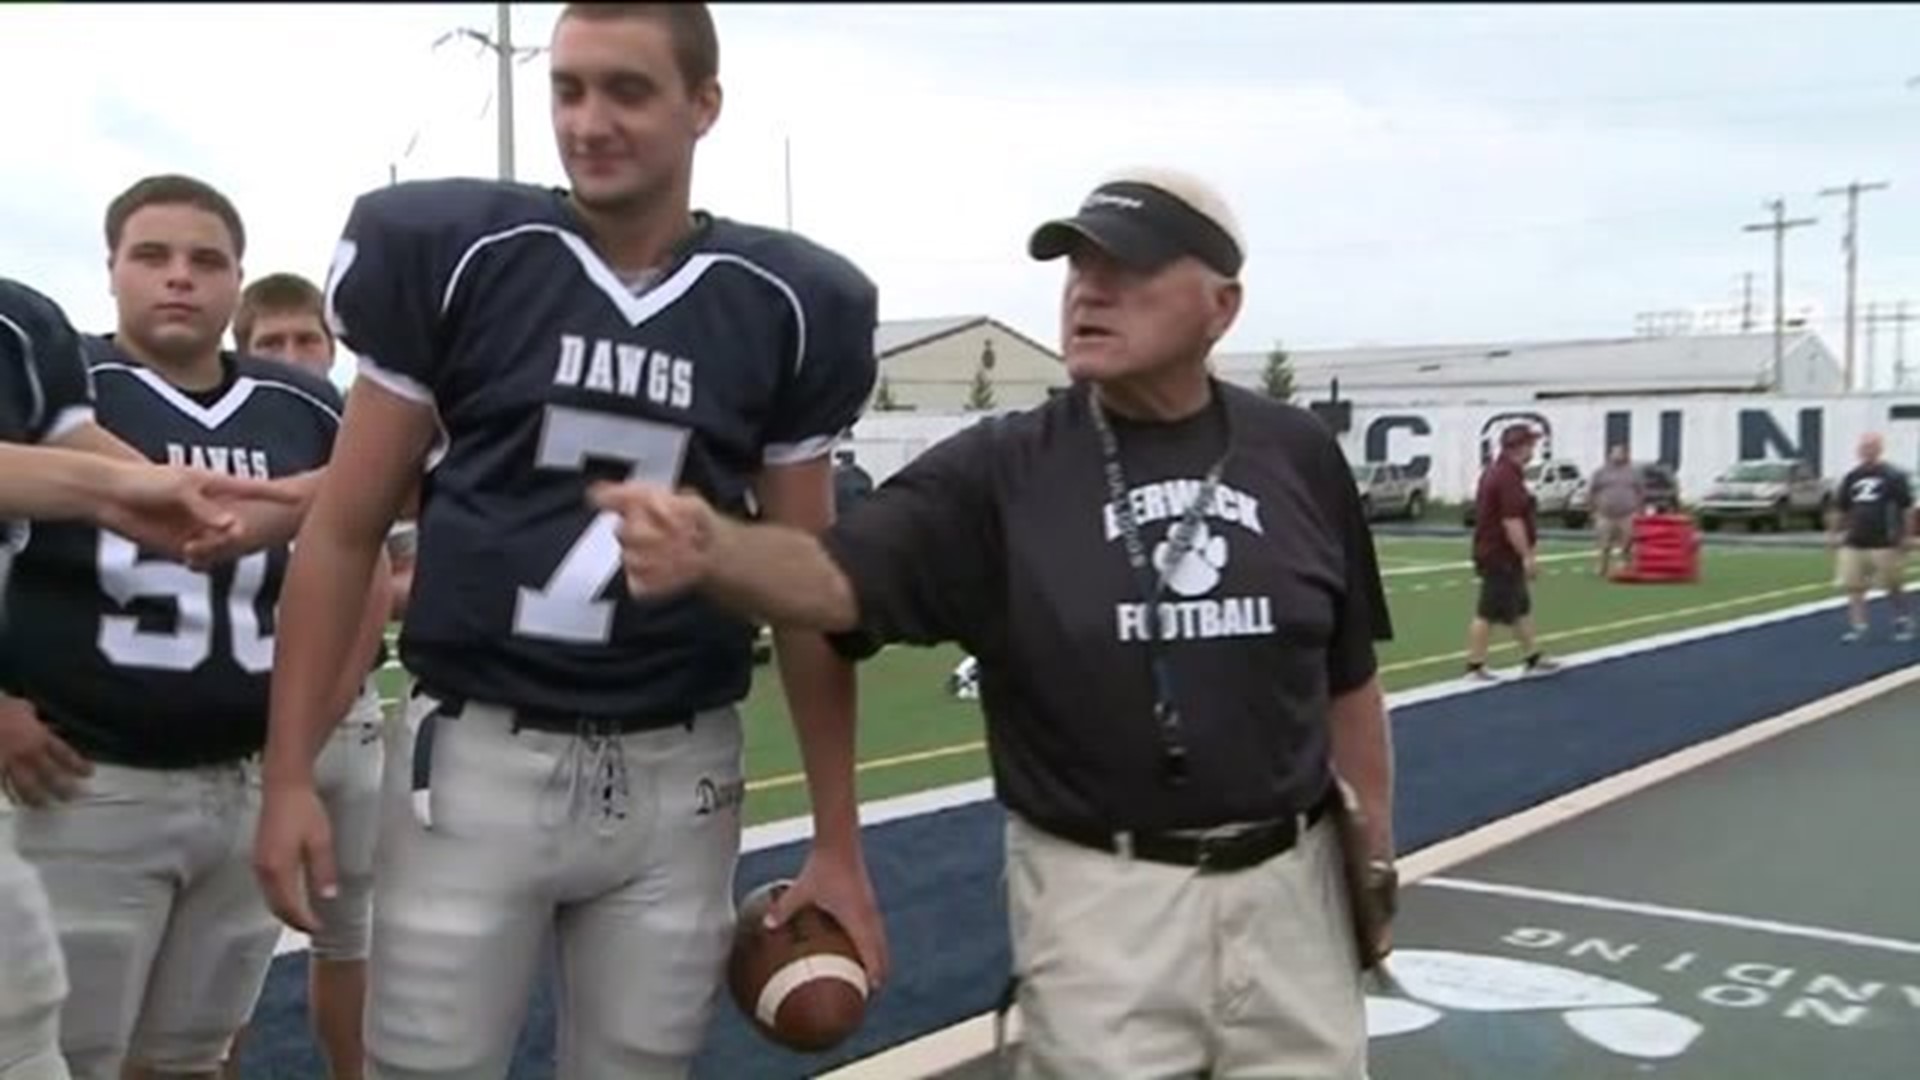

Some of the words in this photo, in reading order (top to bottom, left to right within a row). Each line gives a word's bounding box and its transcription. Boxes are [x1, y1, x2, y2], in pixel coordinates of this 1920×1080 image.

[553, 334, 694, 409] DAWGS
[512, 403, 693, 645] 7
[1103, 479, 1264, 541] ERWCK
